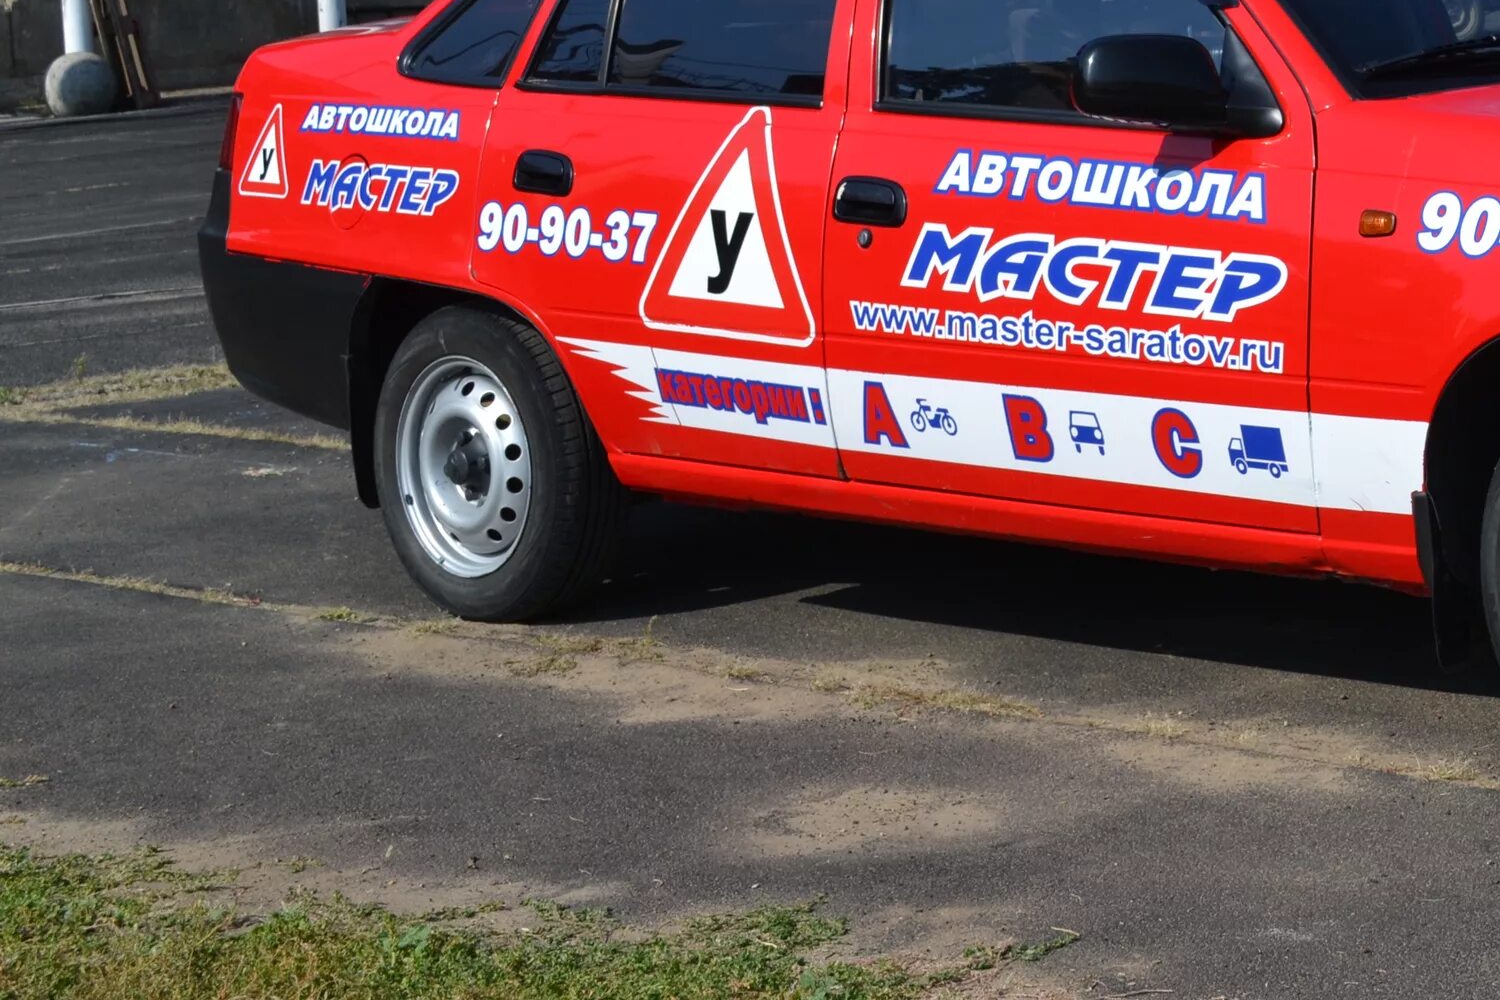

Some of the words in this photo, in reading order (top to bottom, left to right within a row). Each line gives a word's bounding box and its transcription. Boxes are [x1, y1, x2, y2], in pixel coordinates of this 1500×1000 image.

[301, 103, 460, 141] АВТОШКОЛА
[301, 158, 460, 217] МАСТЕР
[934, 147, 1268, 223] АВТОШКОЛА
[476, 201, 658, 264] 90-90-37
[900, 222, 1289, 323] МАСТЕР
[849, 299, 1284, 375] www.master-saratov.ru
